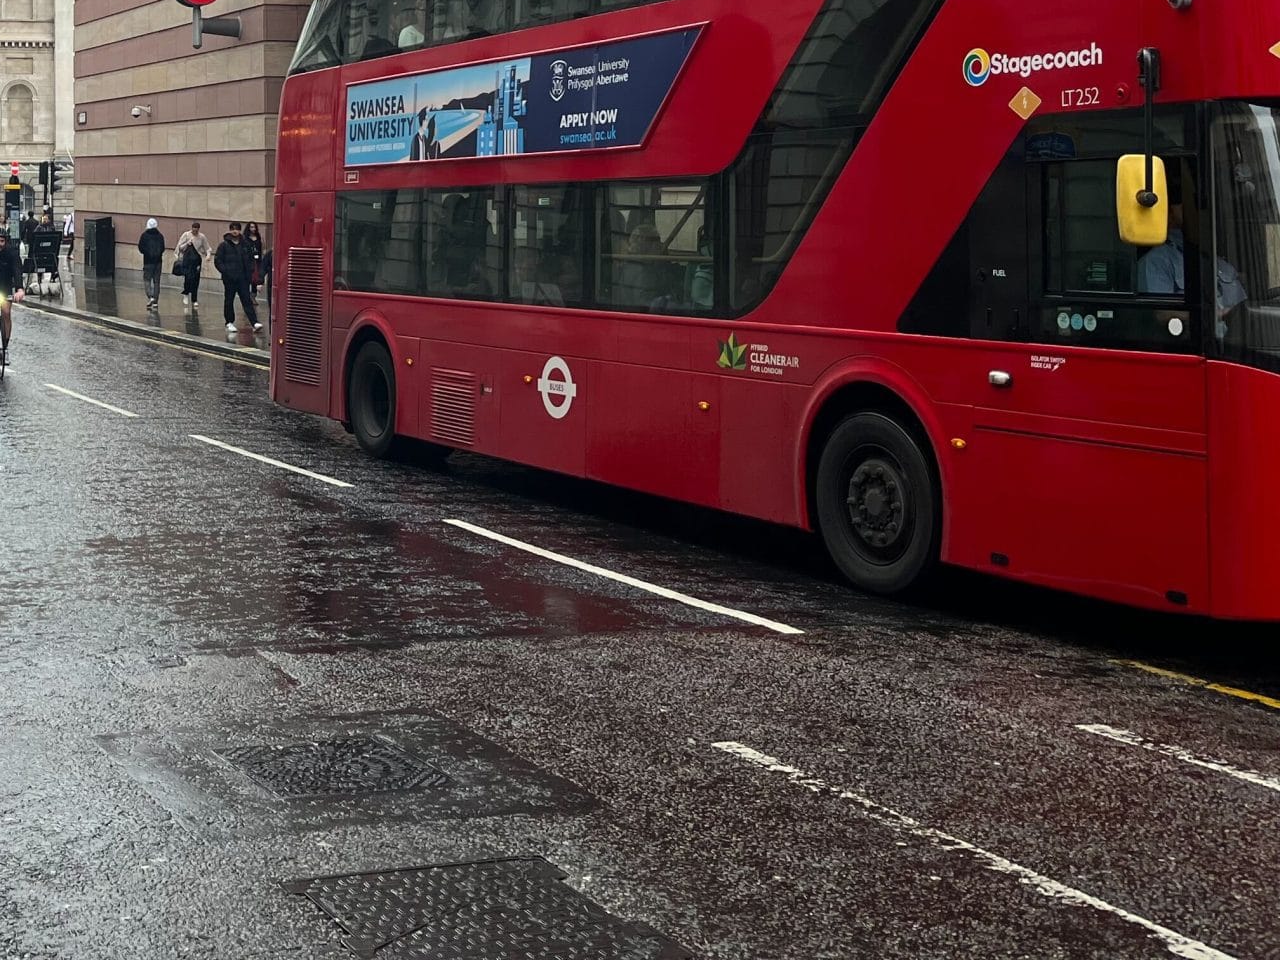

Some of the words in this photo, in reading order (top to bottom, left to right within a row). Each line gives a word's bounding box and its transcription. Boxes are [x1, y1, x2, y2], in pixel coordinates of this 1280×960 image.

[567, 65, 596, 77] Swansea
[598, 57, 630, 72] University
[990, 41, 1103, 78] Stagecoach
[596, 72, 629, 86] Abertawe
[1061, 86, 1100, 107] LT252
[350, 94, 405, 120] SWANSEA
[559, 112, 588, 128] APPLY
[590, 108, 618, 126] NOW
[349, 117, 414, 142] UNIVERSITY
[560, 124, 617, 144] swanseaac.uk
[992, 269, 1006, 277] FUEL
[761, 366, 783, 376] LONDON
[549, 383, 564, 392] BUSES
